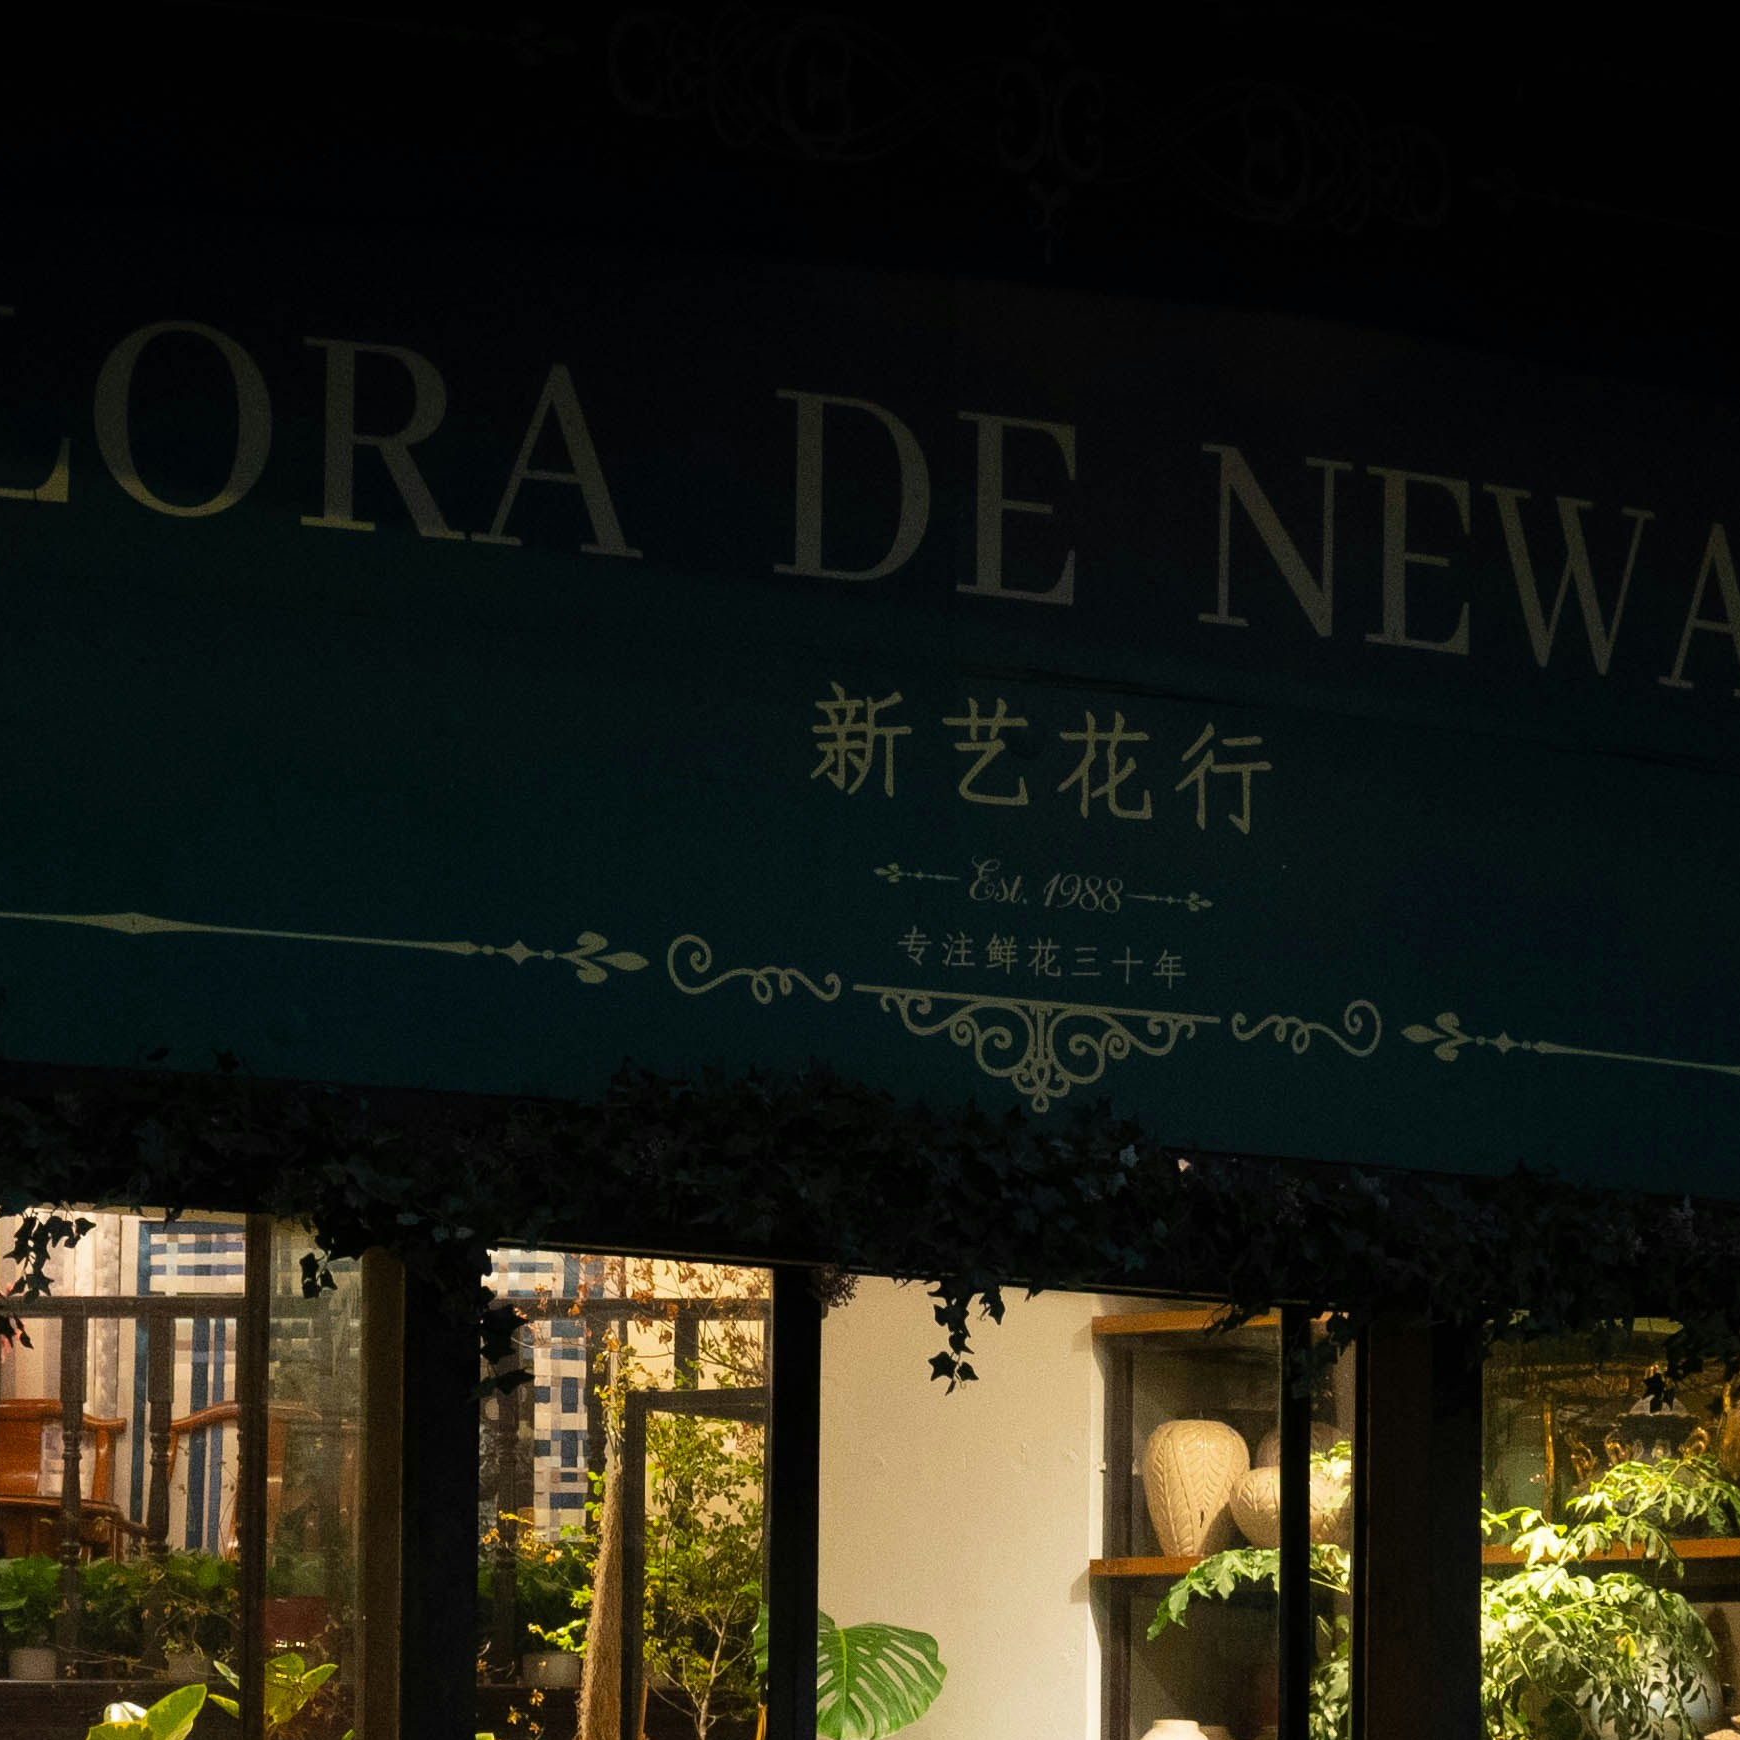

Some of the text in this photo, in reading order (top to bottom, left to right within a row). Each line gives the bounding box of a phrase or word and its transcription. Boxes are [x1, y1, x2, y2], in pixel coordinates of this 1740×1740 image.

[772, 388, 1077, 608] DE
[810, 681, 1272, 834] 新艺花行
[968, 857, 1125, 914] Est. 1988
[897, 925, 1187, 989] 专注鲜花三十年
